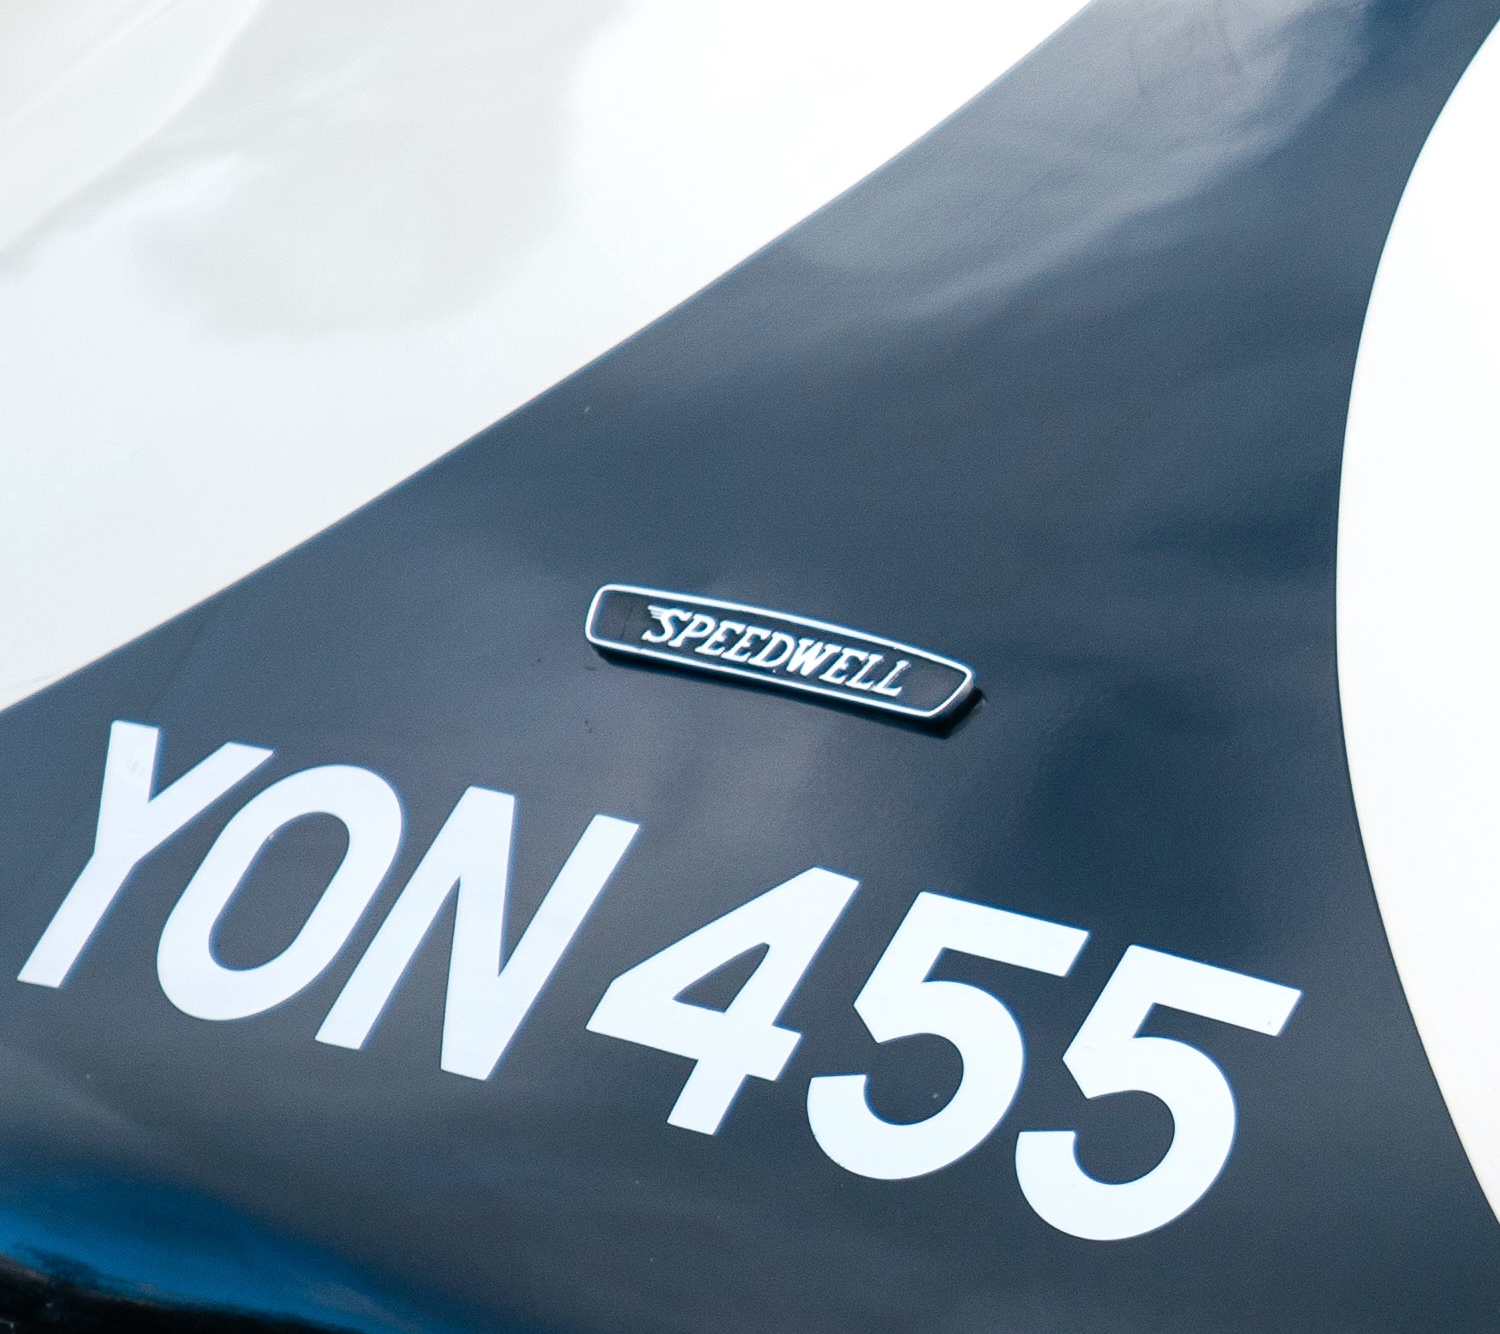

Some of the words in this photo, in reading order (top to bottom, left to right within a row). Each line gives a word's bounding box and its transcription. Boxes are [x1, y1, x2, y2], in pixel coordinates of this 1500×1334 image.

[640, 605, 910, 697] SPEEDWELL
[16, 719, 641, 1082] YON
[585, 866, 1304, 1242] 455
